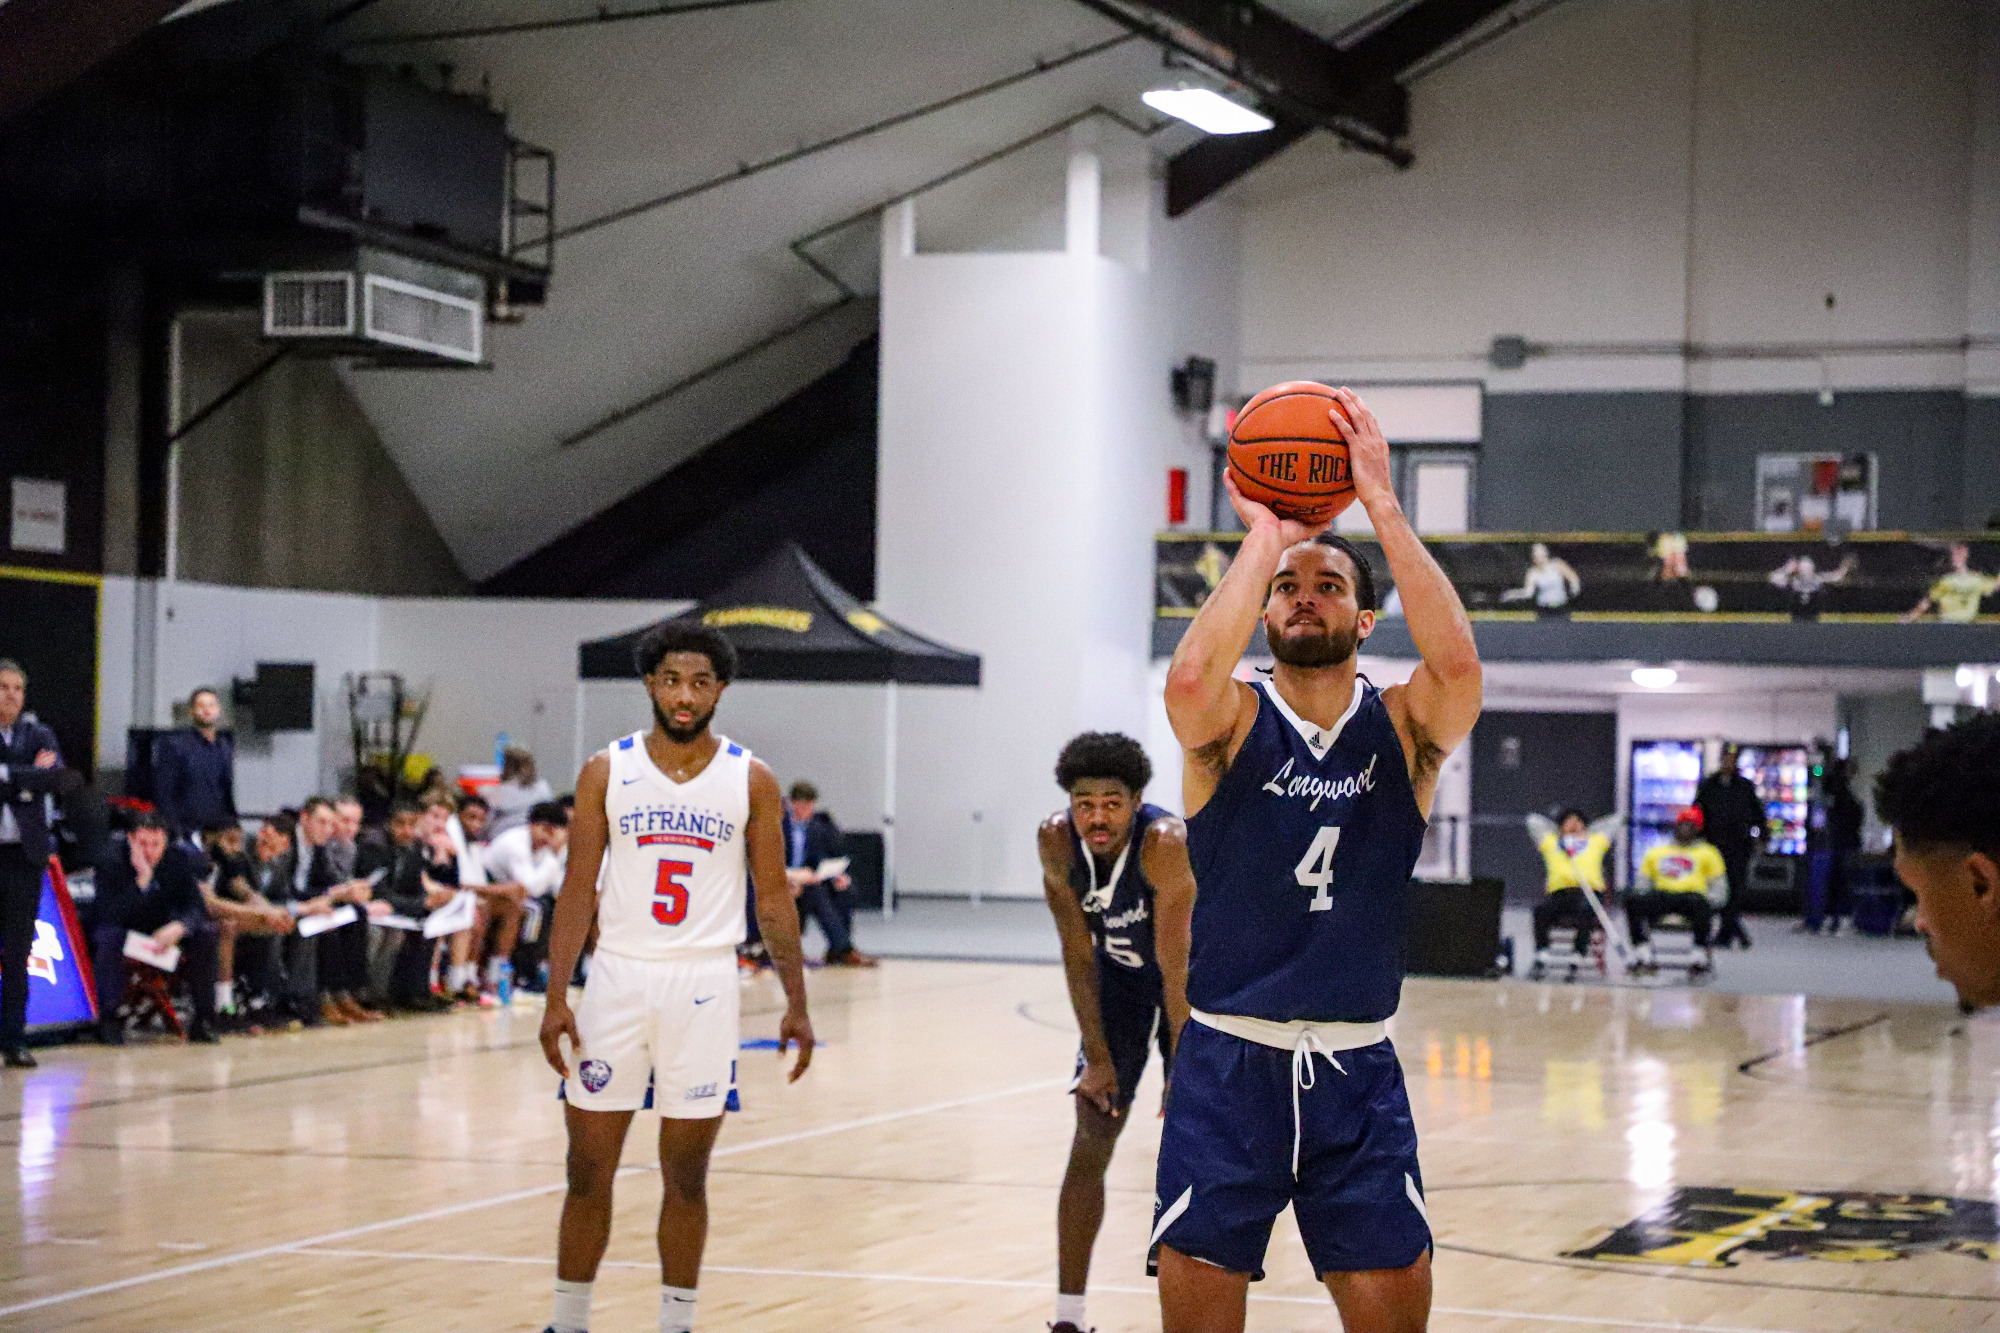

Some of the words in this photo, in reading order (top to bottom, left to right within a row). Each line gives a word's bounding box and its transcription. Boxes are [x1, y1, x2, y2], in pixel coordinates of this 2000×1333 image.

[1258, 452, 1299, 482] THE
[1262, 754, 1377, 811] Longwood
[652, 859, 693, 926] 5
[1294, 826, 1341, 912] 4
